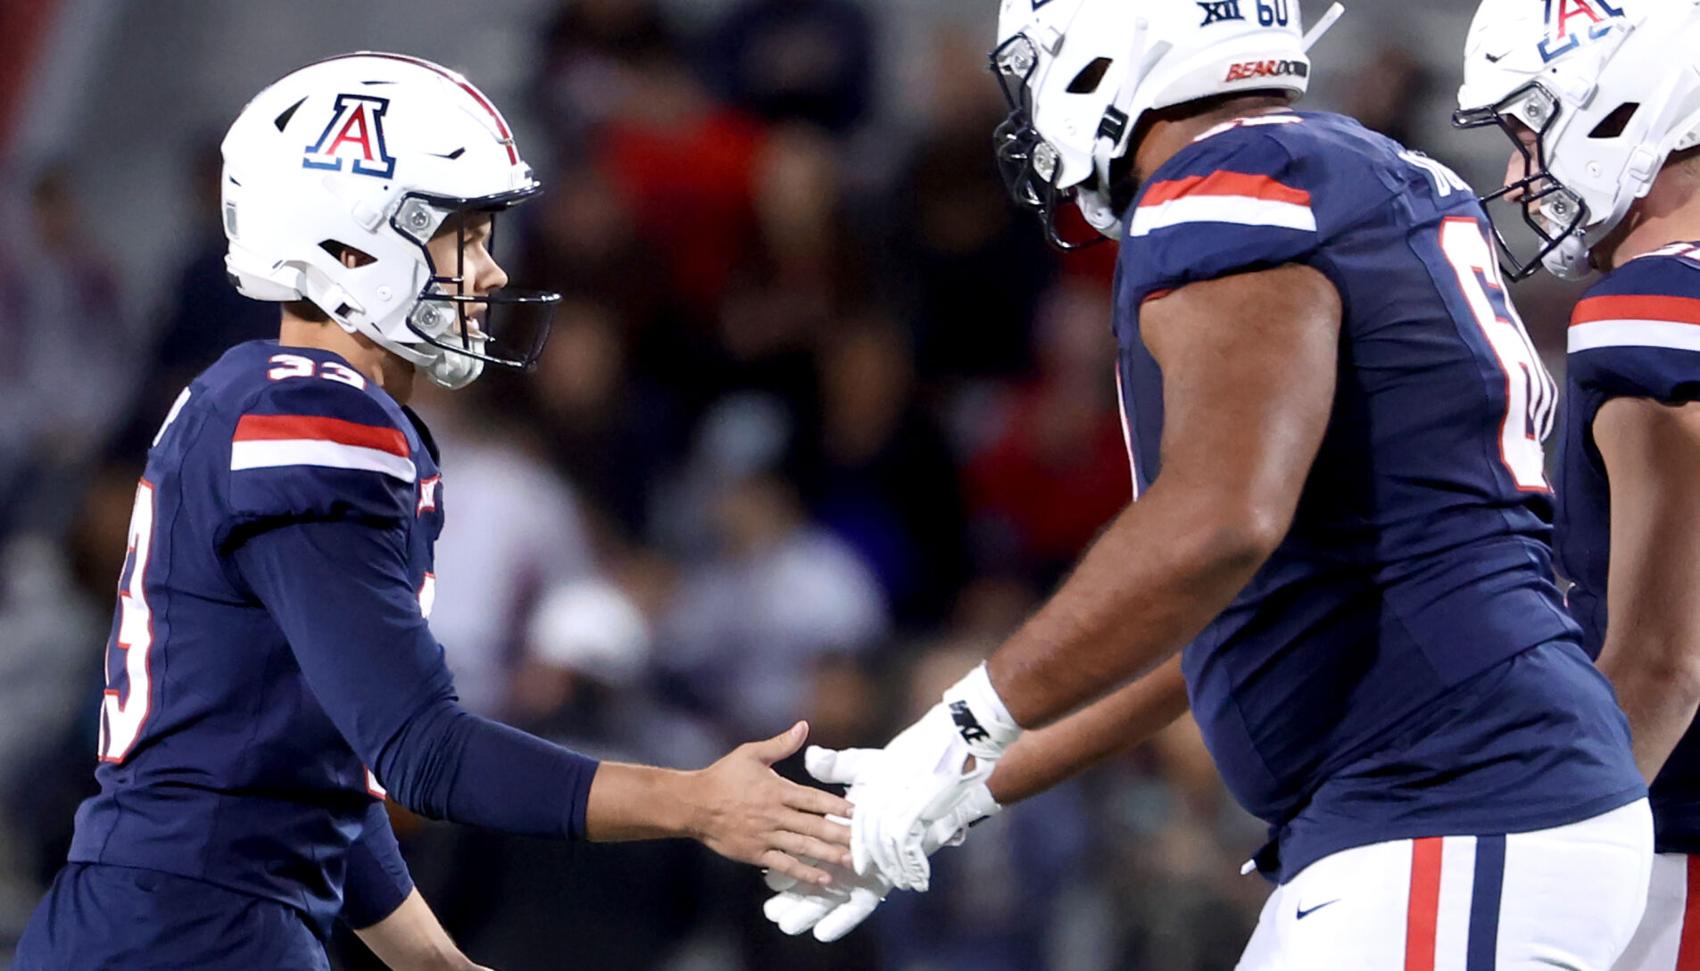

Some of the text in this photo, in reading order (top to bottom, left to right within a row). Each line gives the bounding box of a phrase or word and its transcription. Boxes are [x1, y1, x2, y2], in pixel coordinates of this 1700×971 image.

[1256, 0, 1289, 27] 60
[302, 93, 397, 180] A
[267, 353, 368, 391] 33
[1439, 214, 1559, 495] 6
[98, 477, 155, 766] 3
